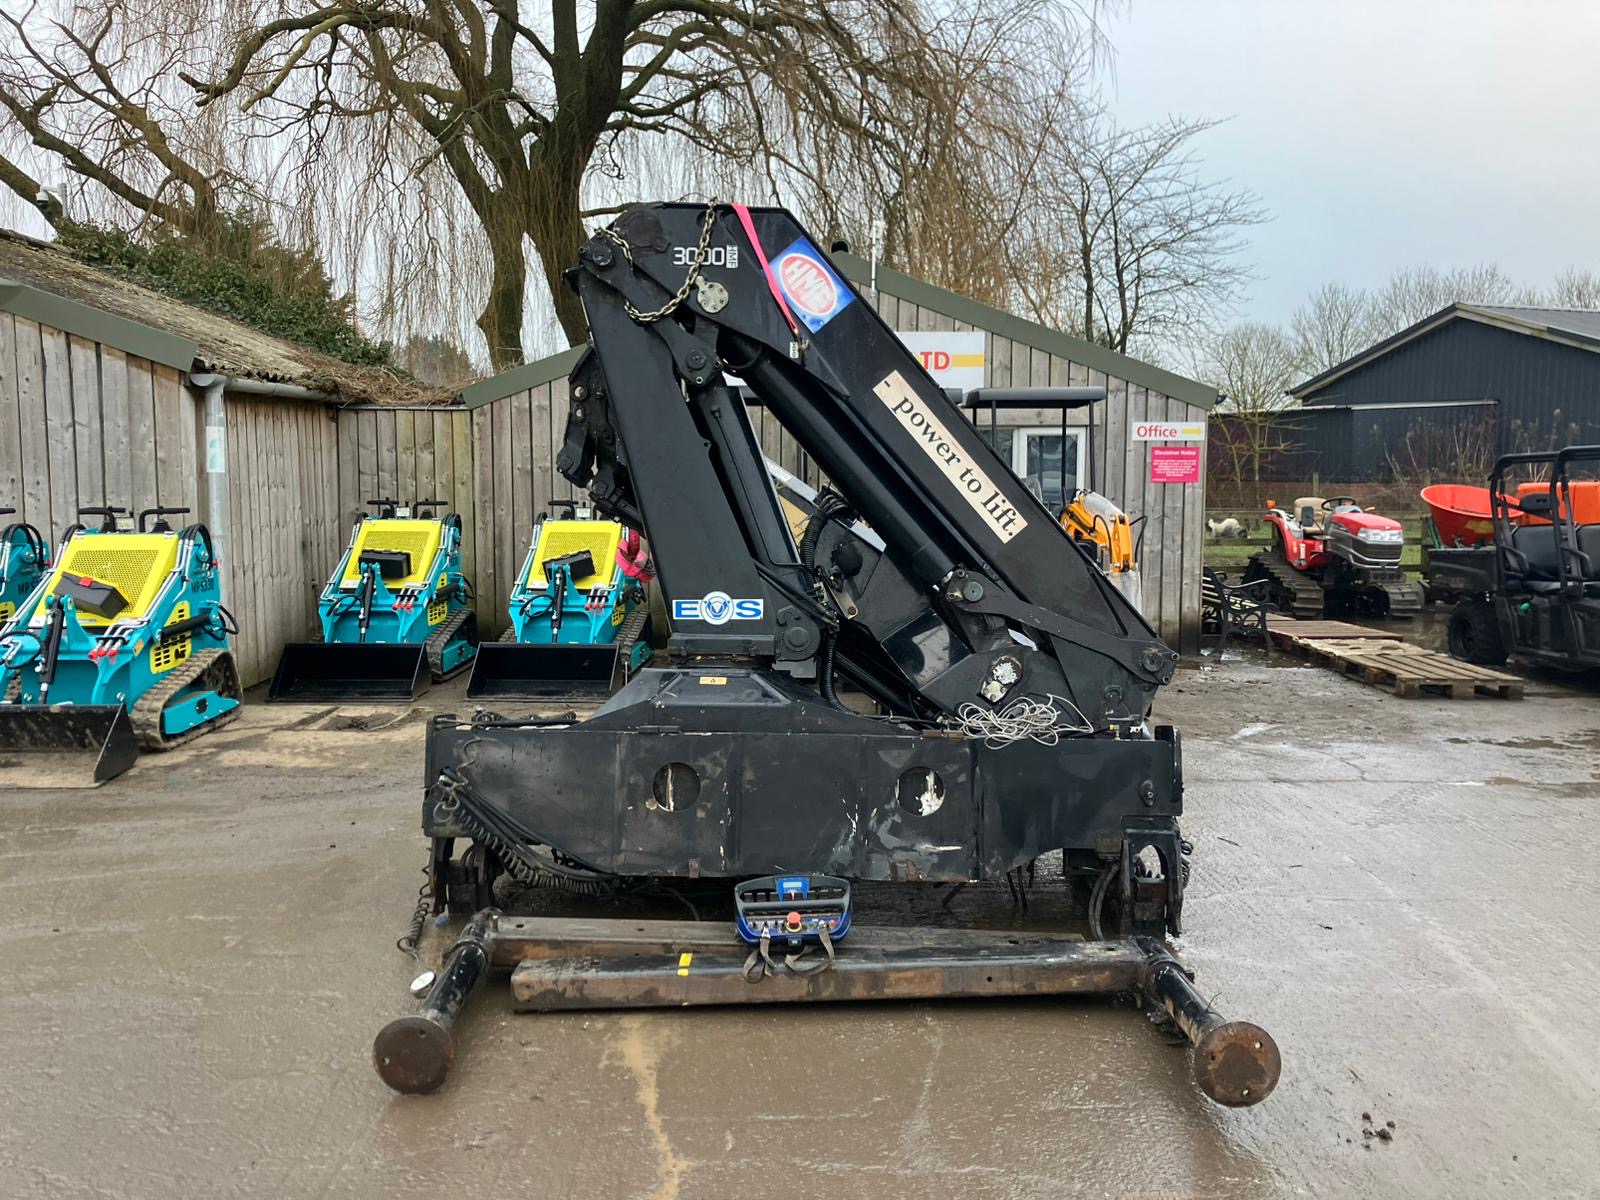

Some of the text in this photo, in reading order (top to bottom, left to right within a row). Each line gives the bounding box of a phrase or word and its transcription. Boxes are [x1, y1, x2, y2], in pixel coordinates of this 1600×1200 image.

[673, 246, 725, 266] 3000
[727, 245, 738, 268] HMF
[919, 351, 950, 370] TD
[1137, 425, 1177, 438] Office
[891, 396, 961, 466] power
[959, 467, 982, 494] to
[981, 490, 1017, 537] lift.
